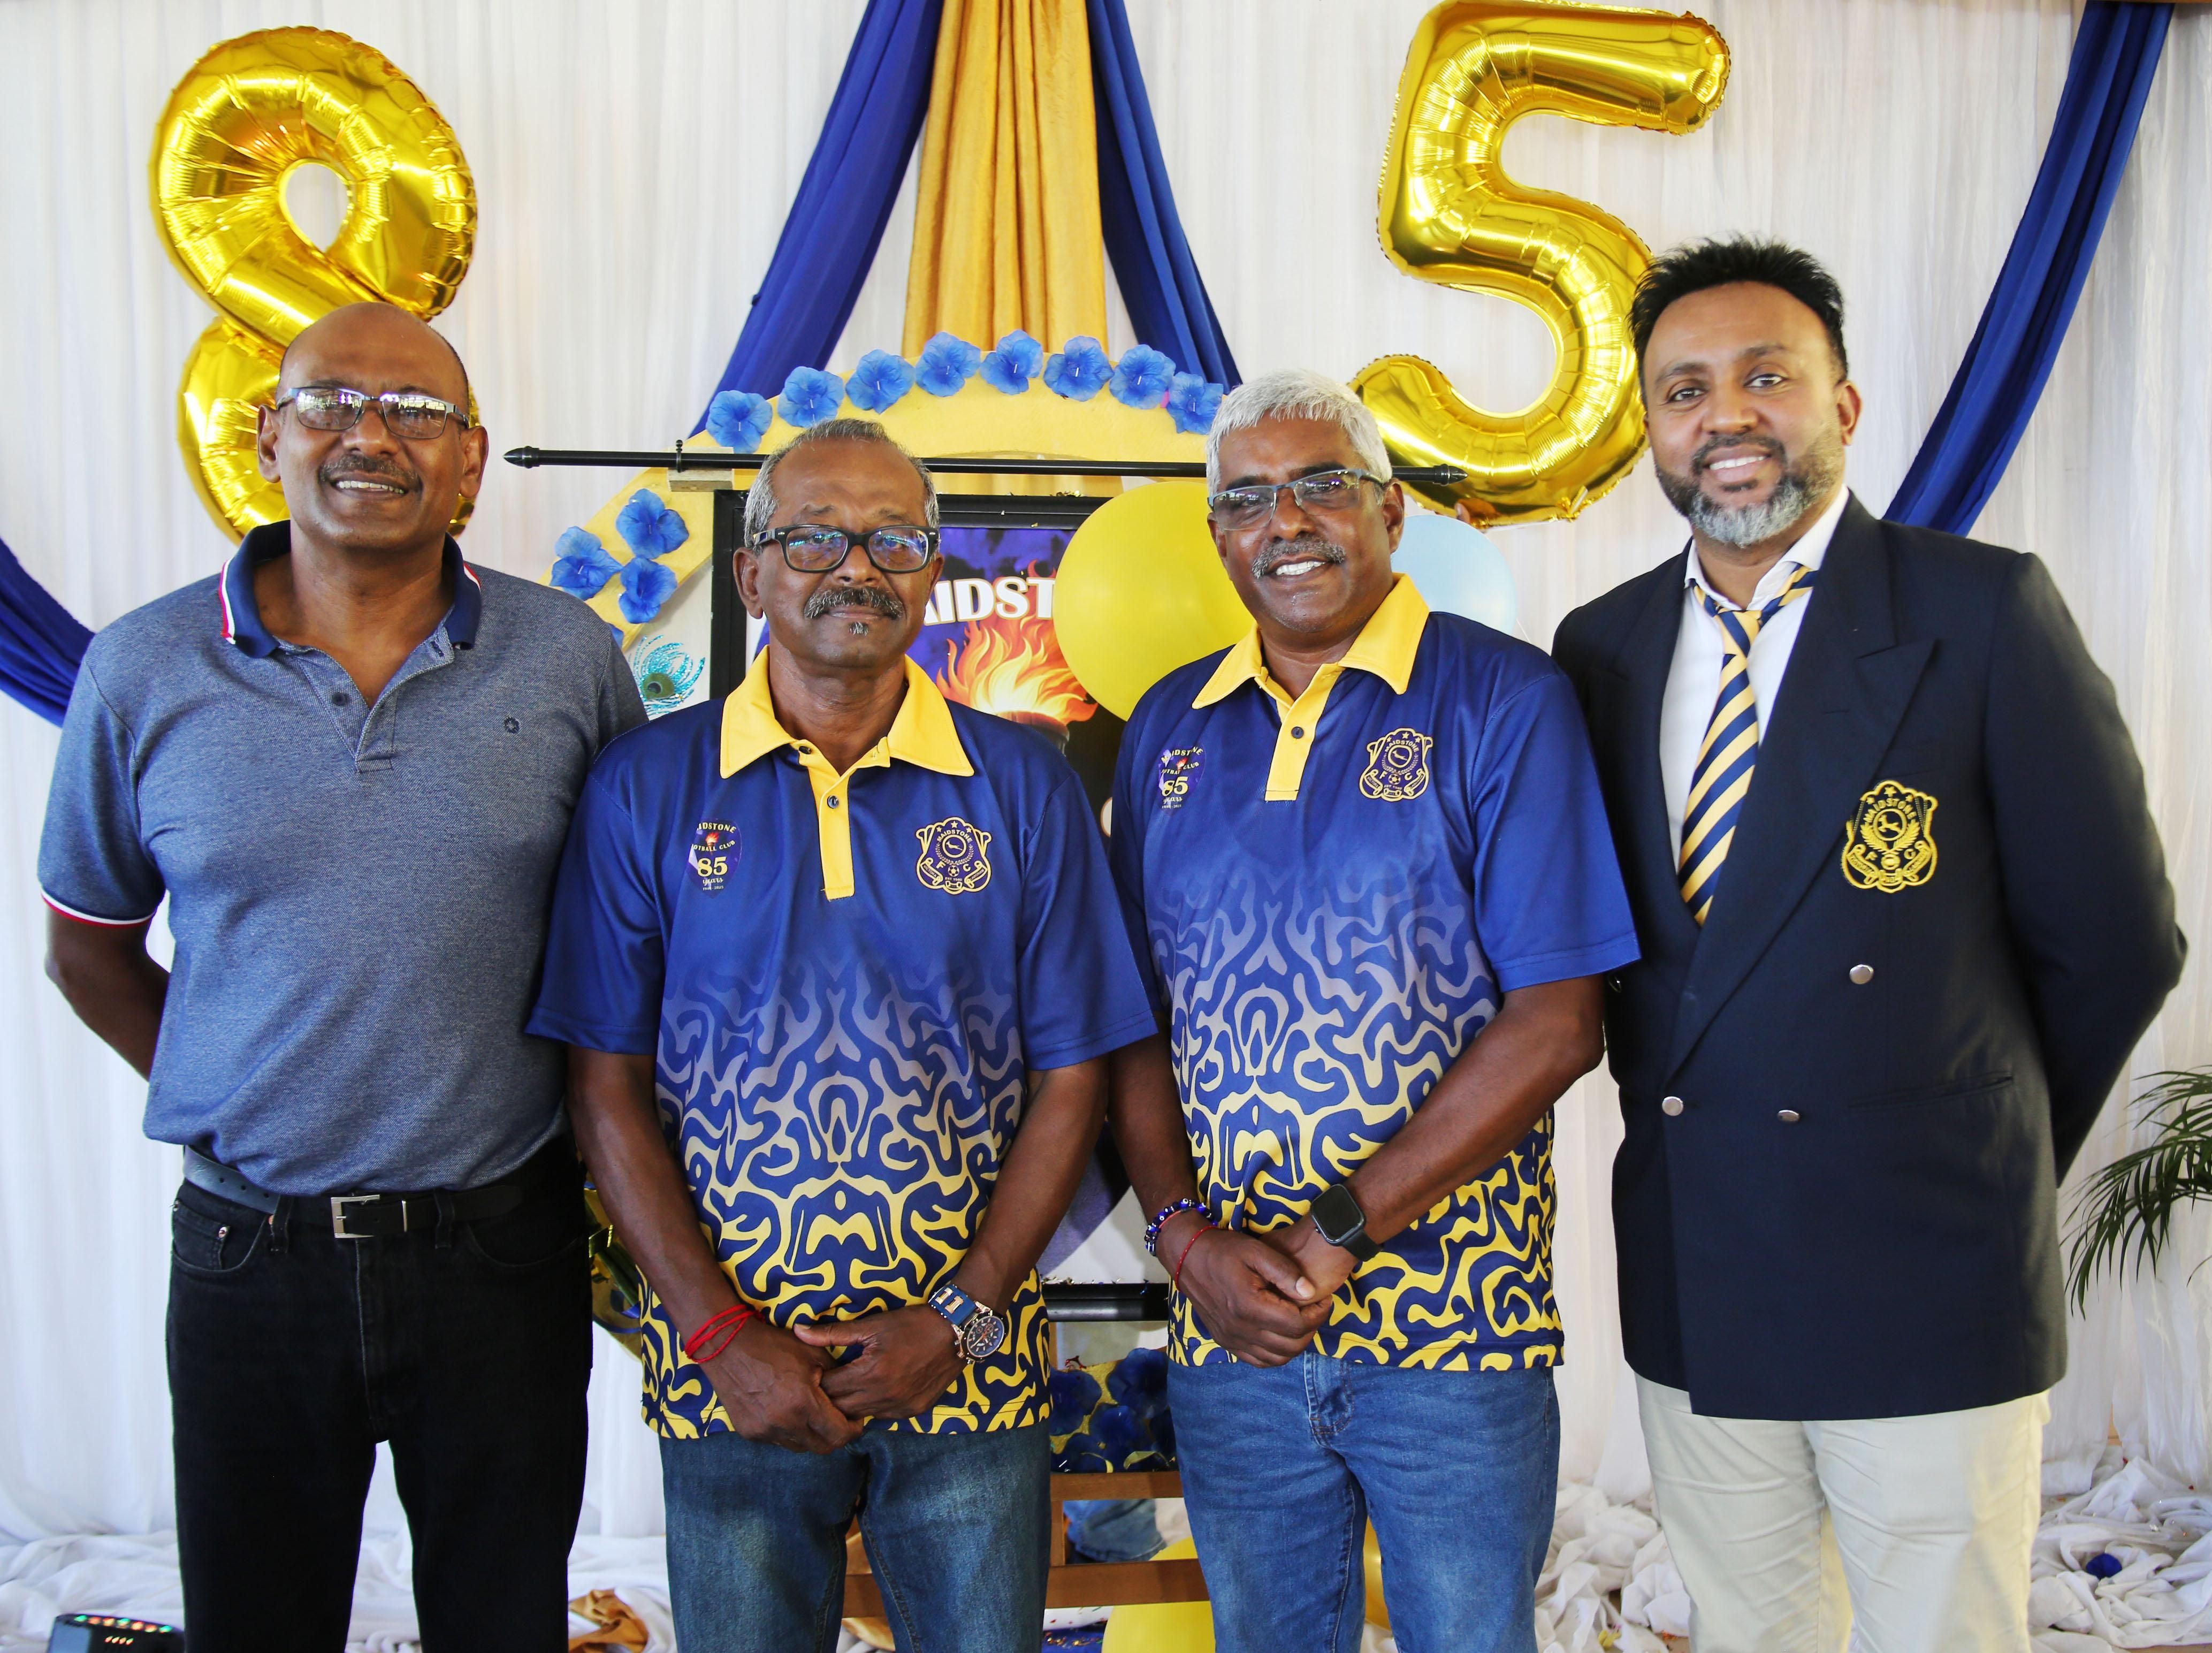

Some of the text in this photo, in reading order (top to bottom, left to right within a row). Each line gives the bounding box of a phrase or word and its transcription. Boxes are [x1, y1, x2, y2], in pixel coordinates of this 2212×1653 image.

[1347, 0, 1731, 529] 5
[1385, 740, 1420, 752] MAIDSTONE
[1183, 761, 1200, 770] CLUB
[1379, 771, 1413, 780] F C
[1162, 776, 1188, 797] 85
[1163, 796, 1183, 804] years
[937, 829, 973, 843] MAIDSTONE
[719, 840, 736, 850] CLUB
[697, 856, 728, 877] 85
[936, 860, 971, 872] F C
[703, 877, 724, 886] years
